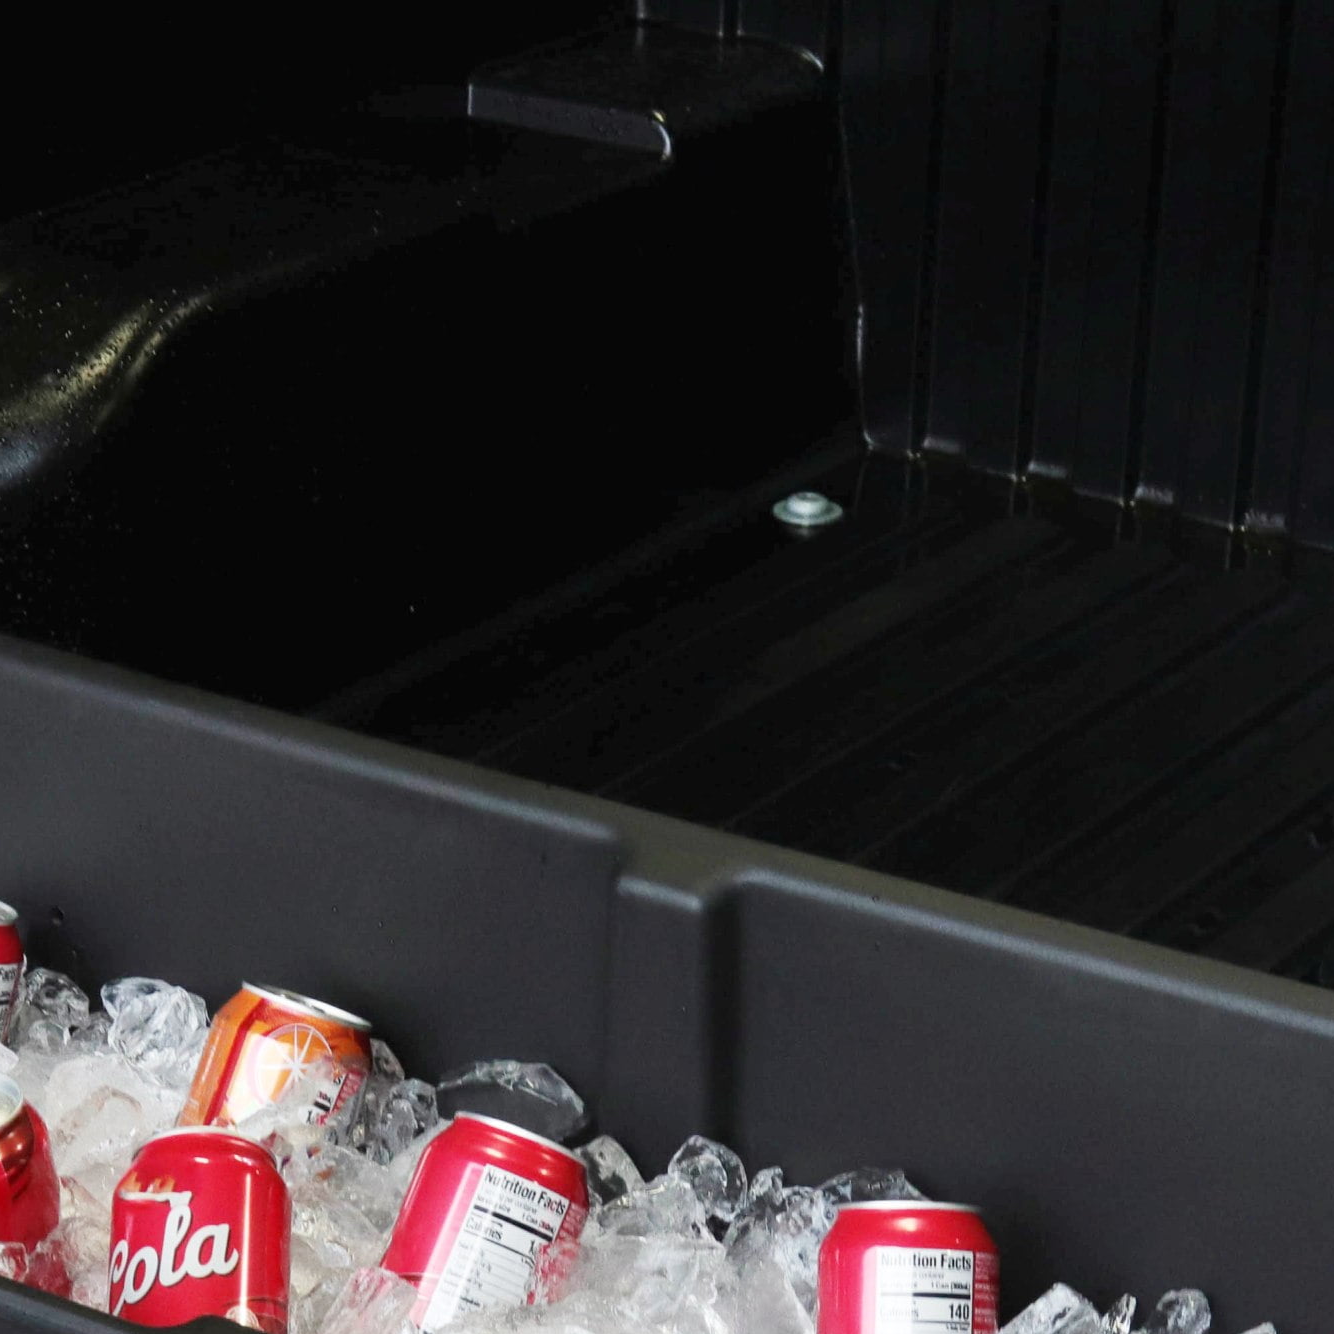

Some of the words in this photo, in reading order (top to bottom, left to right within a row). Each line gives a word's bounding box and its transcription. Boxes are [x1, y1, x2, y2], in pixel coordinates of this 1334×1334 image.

[537, 1190, 567, 1216] Facts
[940, 1253, 971, 1271] Facts
[949, 1303, 970, 1321] 140
